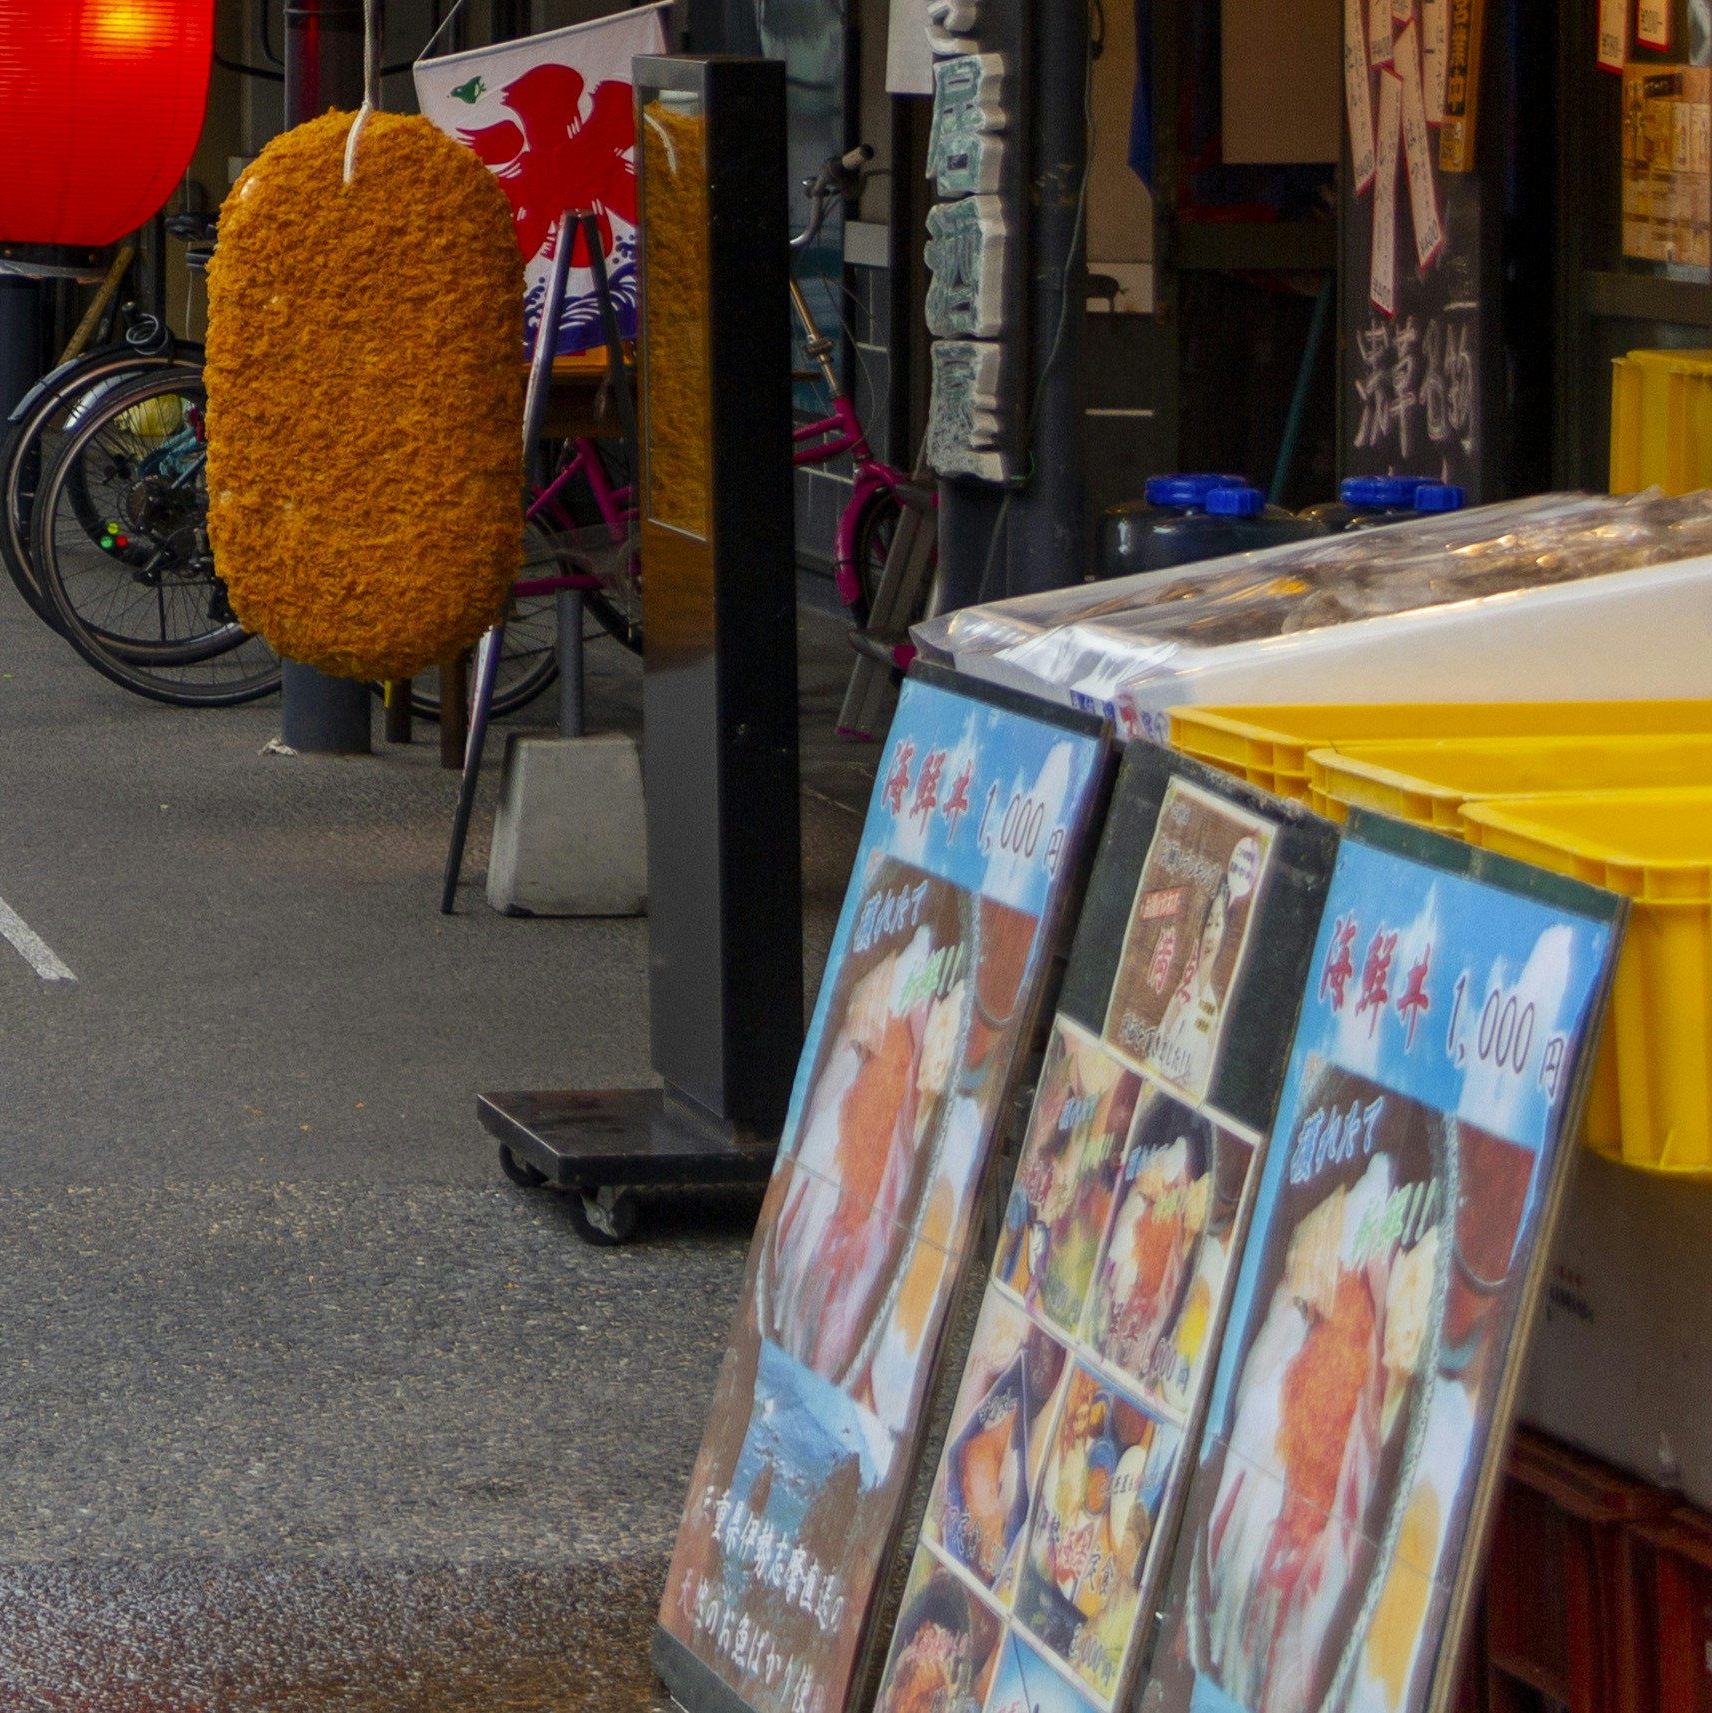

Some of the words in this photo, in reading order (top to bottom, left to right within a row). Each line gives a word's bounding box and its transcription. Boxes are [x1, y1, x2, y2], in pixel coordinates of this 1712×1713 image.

[882, 737, 972, 848] 海鮮丼
[1320, 909, 1431, 1052] 海鮮丼
